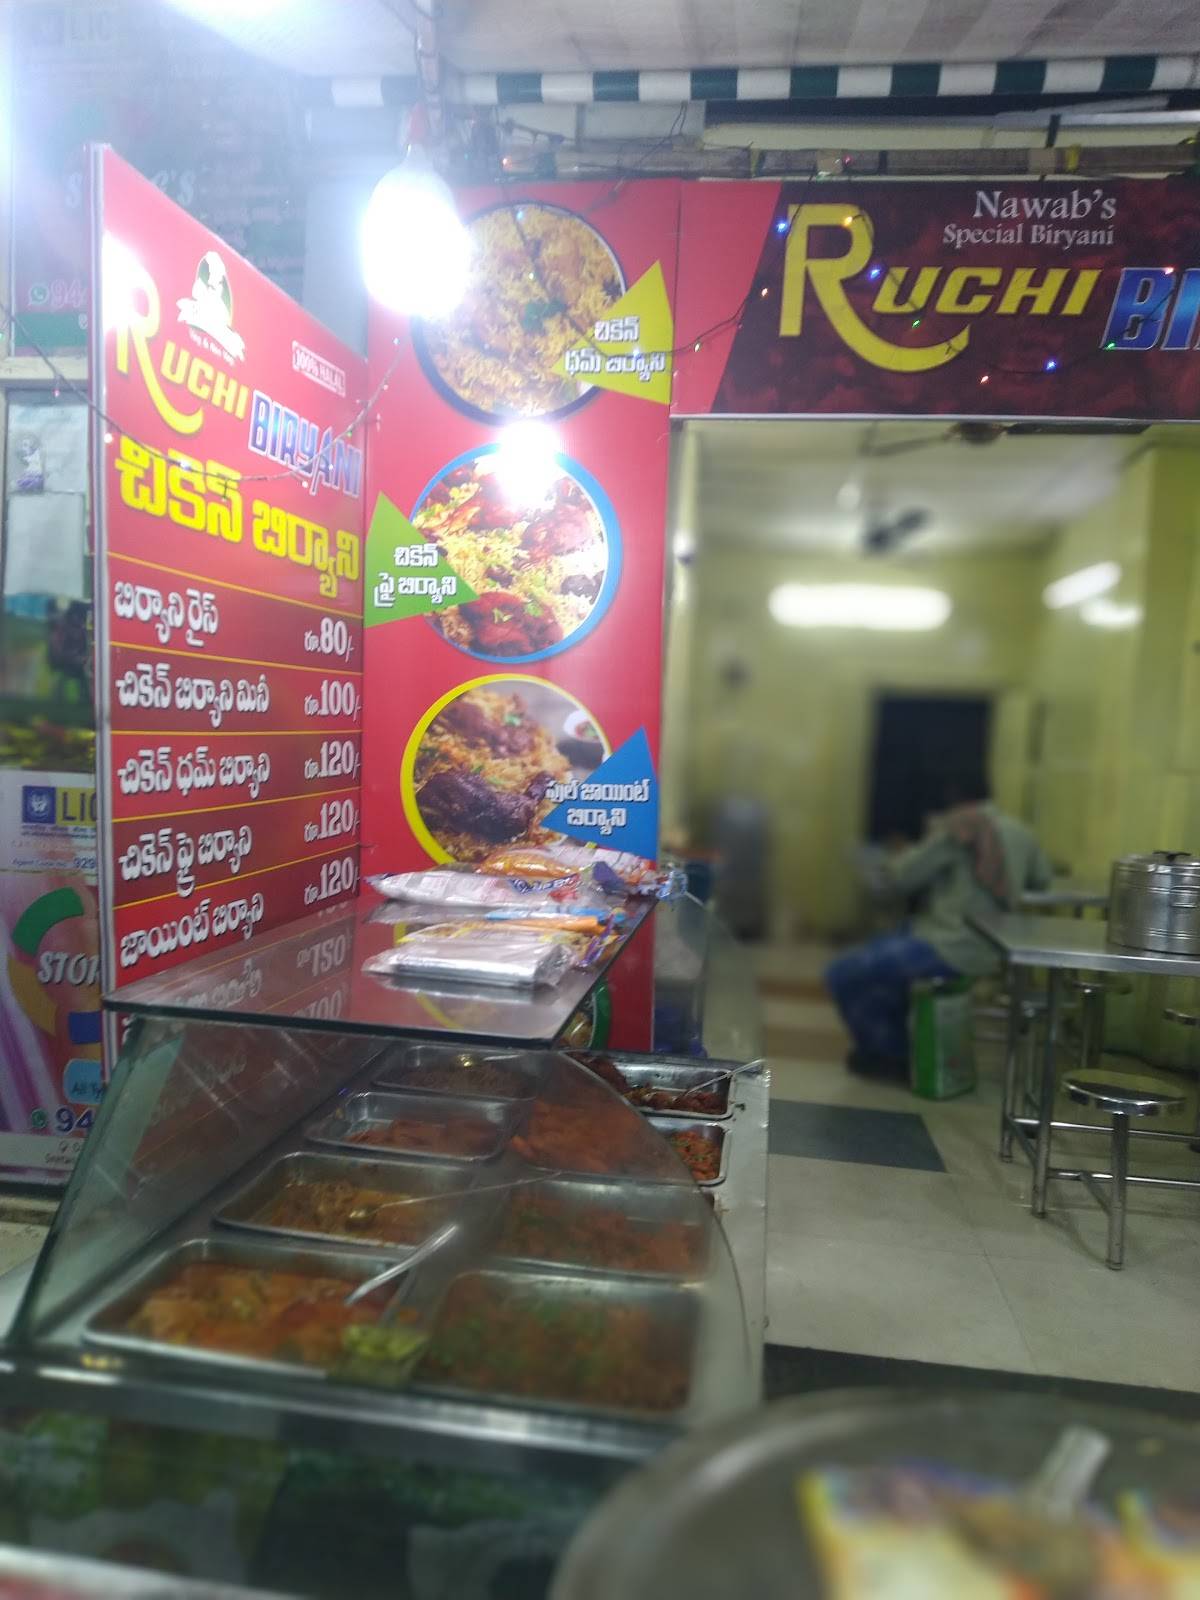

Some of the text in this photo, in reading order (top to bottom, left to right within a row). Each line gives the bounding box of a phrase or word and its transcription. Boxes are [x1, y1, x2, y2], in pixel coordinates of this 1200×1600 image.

[973, 189, 1117, 219] Nawab's
[943, 223, 1114, 250] Special Biryani
[779, 203, 1102, 372] RUCHI
[108, 262, 362, 498] RUCHI BIRYANI
[115, 435, 360, 598] చికెన్ బిర్యాని
[394, 543, 438, 567] చికెన్
[114, 581, 184, 644] బిర్యాని
[186, 588, 219, 647] రైస్
[116, 663, 172, 708] చికెన్
[175, 676, 234, 728] బిర్యాని
[117, 746, 173, 794] చికెన్
[219, 752, 271, 799] బిర్యాని
[119, 827, 173, 881] చికెన్
[198, 825, 252, 873] బిర్యాని
[213, 893, 264, 939] బిర్యాని
